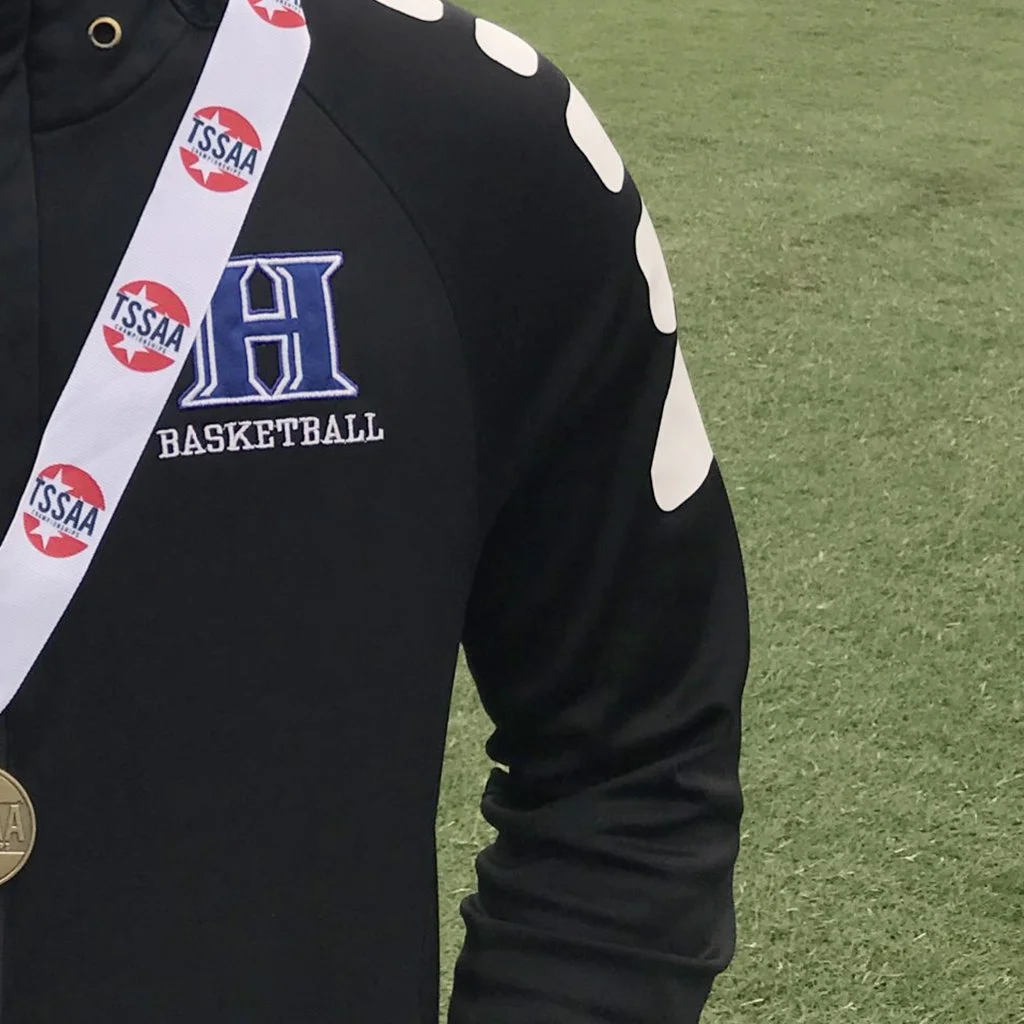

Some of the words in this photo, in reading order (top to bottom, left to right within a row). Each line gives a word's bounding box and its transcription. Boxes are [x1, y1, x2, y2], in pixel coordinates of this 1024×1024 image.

[187, 117, 258, 175] TSSAA
[111, 292, 184, 352] TSSAA
[177, 250, 359, 410] H
[156, 412, 384, 459] BASKETBALL
[29, 477, 98, 536] TSSAA
